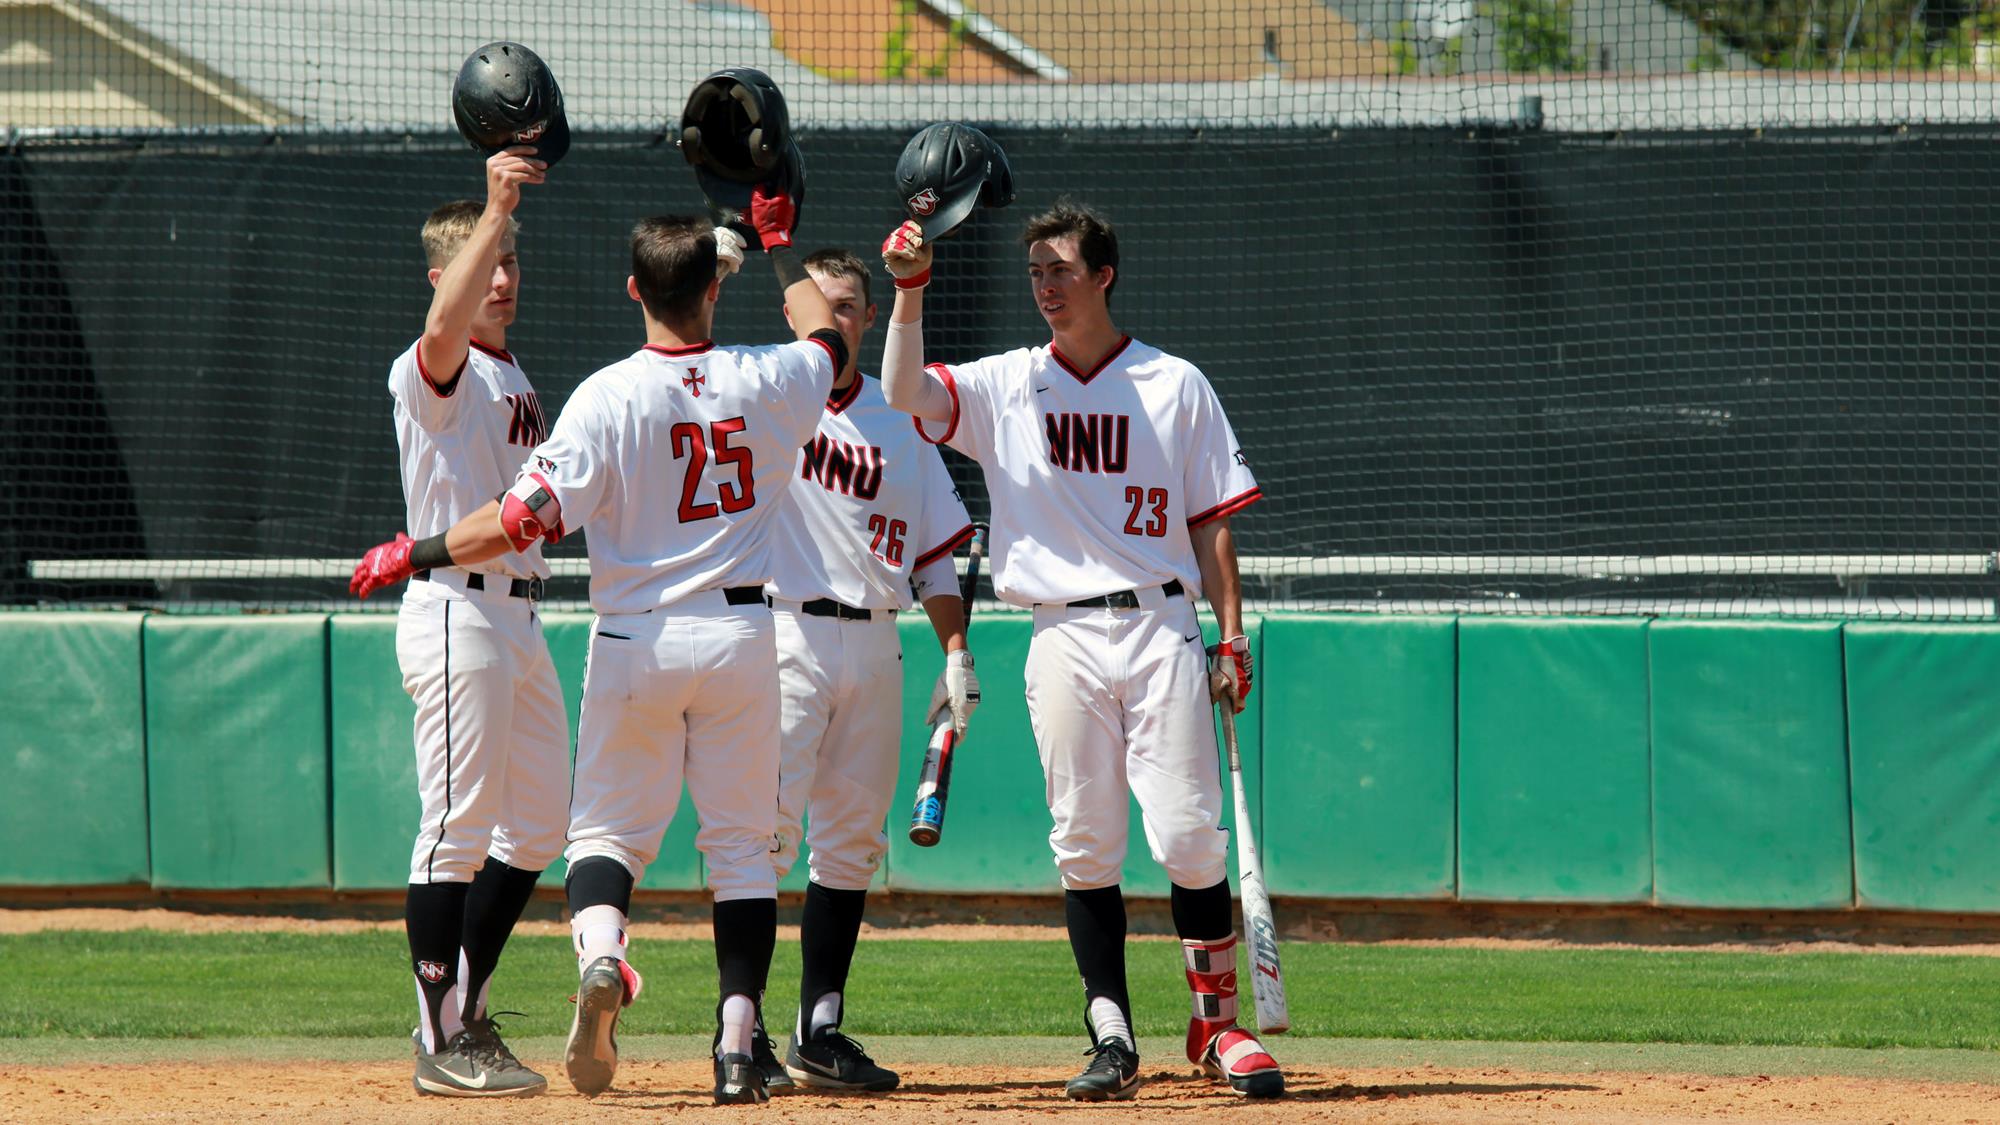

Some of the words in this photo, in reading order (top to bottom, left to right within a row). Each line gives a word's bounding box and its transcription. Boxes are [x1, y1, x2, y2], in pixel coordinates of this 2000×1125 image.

[670, 416, 755, 523] 25
[802, 431, 883, 501] NNU
[1045, 413, 1130, 474] NNU
[868, 513, 908, 568] 26
[1123, 485, 1169, 538] 23
